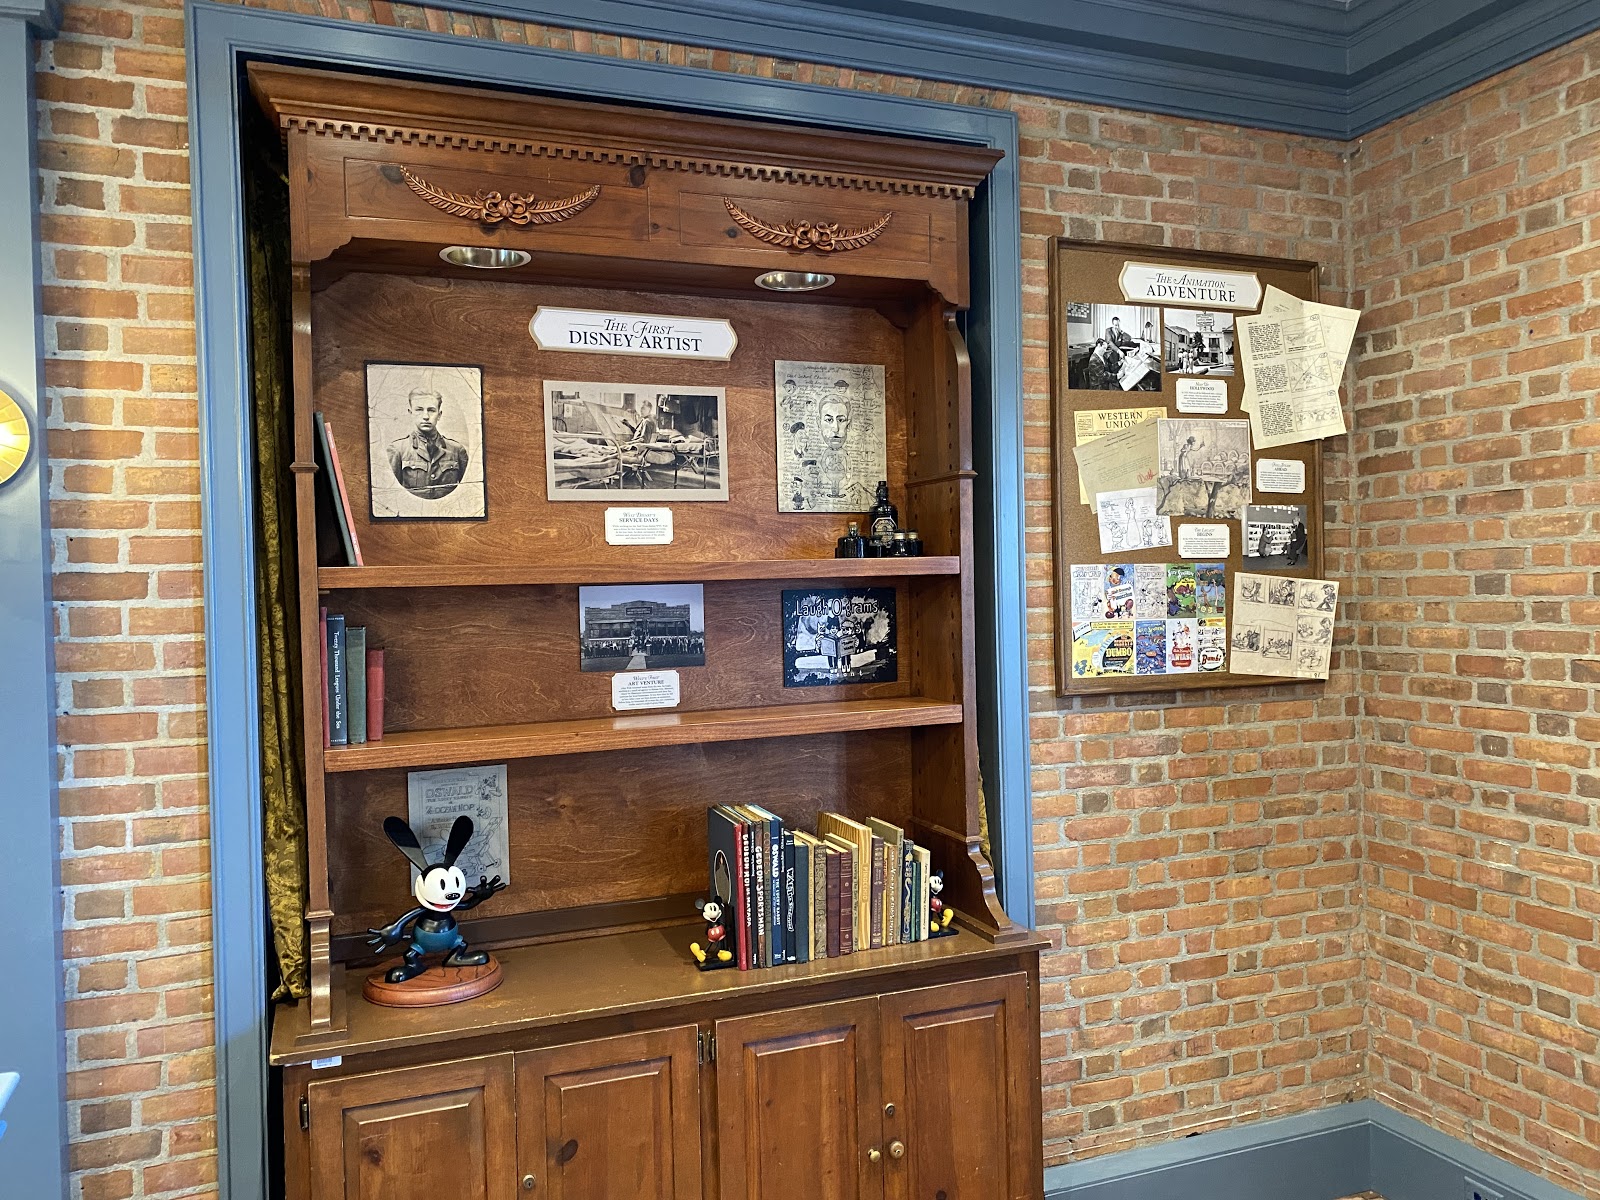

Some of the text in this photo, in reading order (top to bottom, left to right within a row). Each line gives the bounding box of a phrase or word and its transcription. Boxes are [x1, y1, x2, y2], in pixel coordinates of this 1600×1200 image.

[1174, 274, 1226, 288] ANIMATION
[1146, 285, 1236, 302] ADVENTURE
[632, 320, 674, 338] FIRST
[568, 330, 703, 352] DISNEY ARTIST
[1098, 412, 1143, 420] WESTERN
[1106, 420, 1138, 429] UNION
[796, 599, 828, 618] Laugh
[1105, 647, 1132, 658] DUMBO
[1202, 654, 1222, 665] Bambi
[425, 785, 474, 798] OSWALD
[755, 846, 764, 936] GEDEON SPORTSMAN
